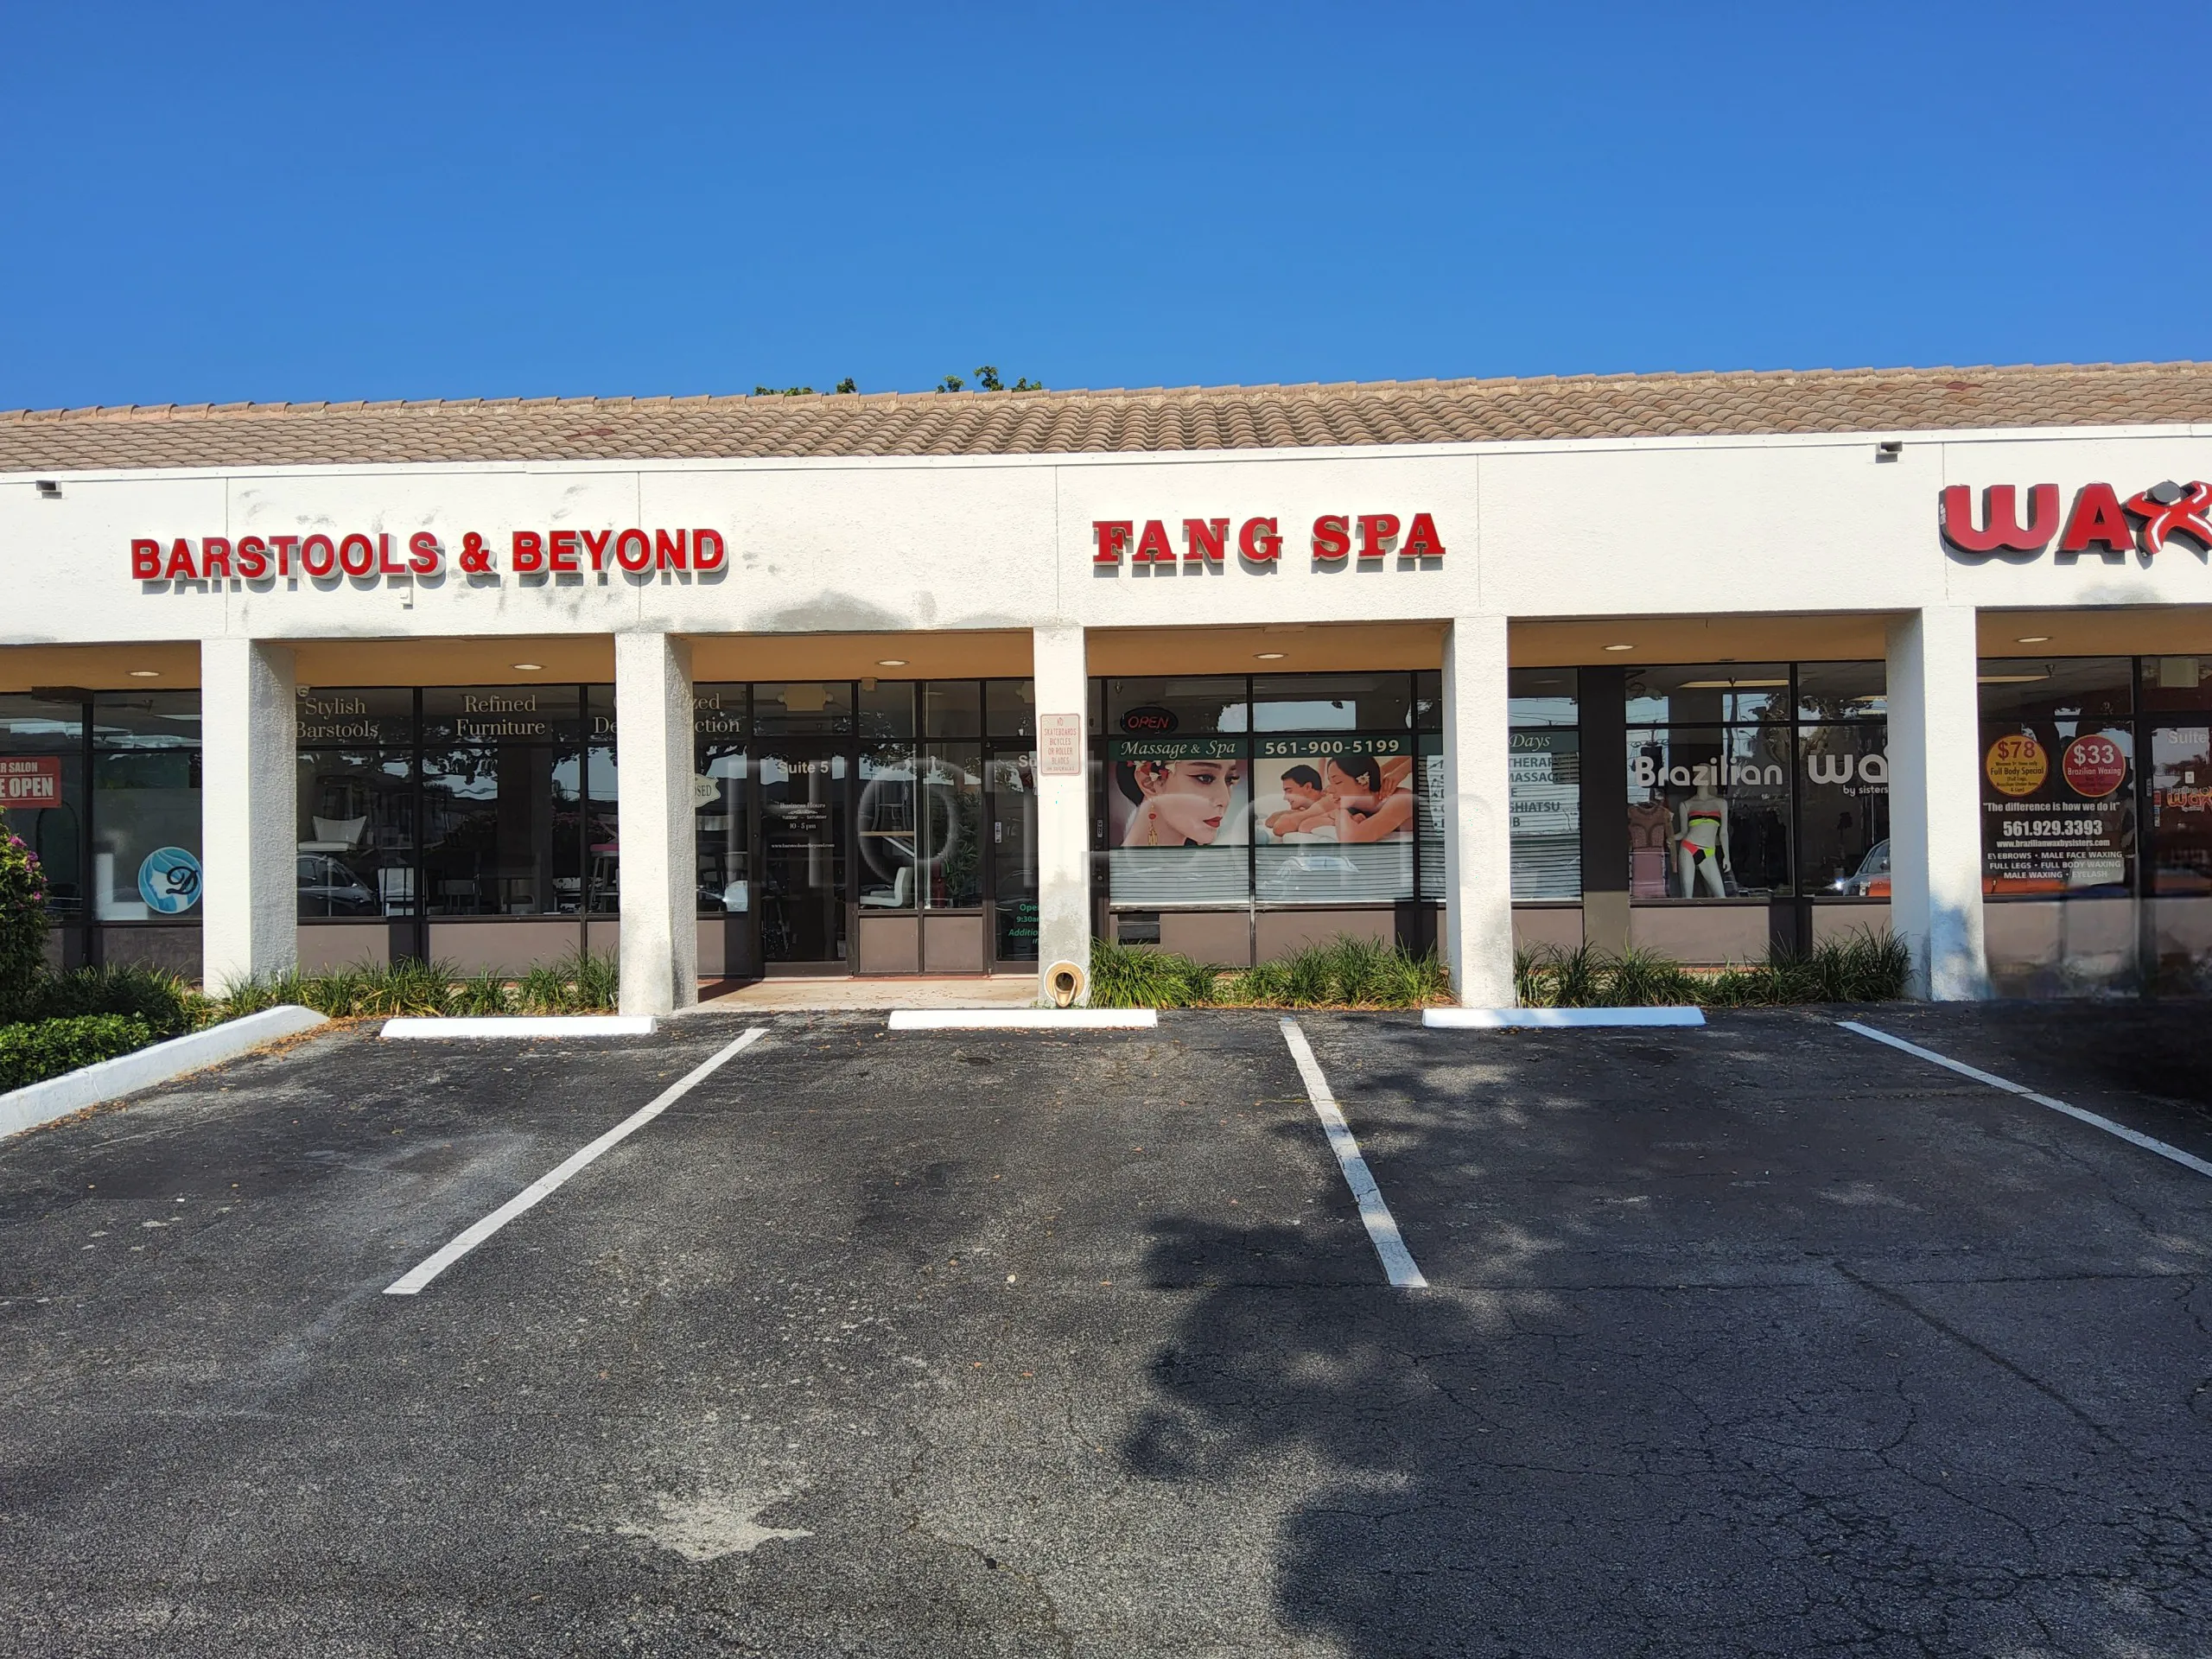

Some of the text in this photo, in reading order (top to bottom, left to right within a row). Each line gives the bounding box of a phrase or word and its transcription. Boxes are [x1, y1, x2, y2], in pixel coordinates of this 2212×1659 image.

[1092, 512, 1446, 565] FANG SPA
[130, 528, 728, 580] BARSTOOLS & BEYOND
[305, 697, 366, 720] Stylish
[464, 694, 537, 713] Refined
[456, 718, 546, 736] Furniture
[1128, 715, 1169, 728] OPEN
[296, 720, 378, 739] Barstools
[1044, 728, 1077, 736] SKATEBOARDS
[2168, 730, 2208, 743] Suite
[1121, 739, 1236, 758] Massage & Spa
[1265, 739, 1400, 754] 561-900-5199
[1510, 734, 1551, 752] Days
[1047, 747, 1074, 755] OR ROLLER
[1998, 741, 2036, 760] $78
[2074, 744, 2114, 766] $33
[9, 761, 38, 773] SALON
[778, 760, 830, 774] Suite 5
[1051, 757, 1070, 766] BLADES
[1636, 753, 1888, 787] Brazilian wa
[2005, 766, 2020, 776] Body
[2021, 766, 2044, 776] Special
[2067, 766, 2121, 777] Brazilian Waxing
[9, 777, 54, 798] OPEN
[1843, 784, 1889, 797] by sisters
[1983, 802, 2120, 812] "The difference is how we do it"
[2003, 820, 2103, 836] 561.929.3393
[1996, 839, 2111, 849] www.brazilianwaxbysisters.com
[1020, 903, 1039, 913] Ope
[1007, 928, 1039, 937] Additio
